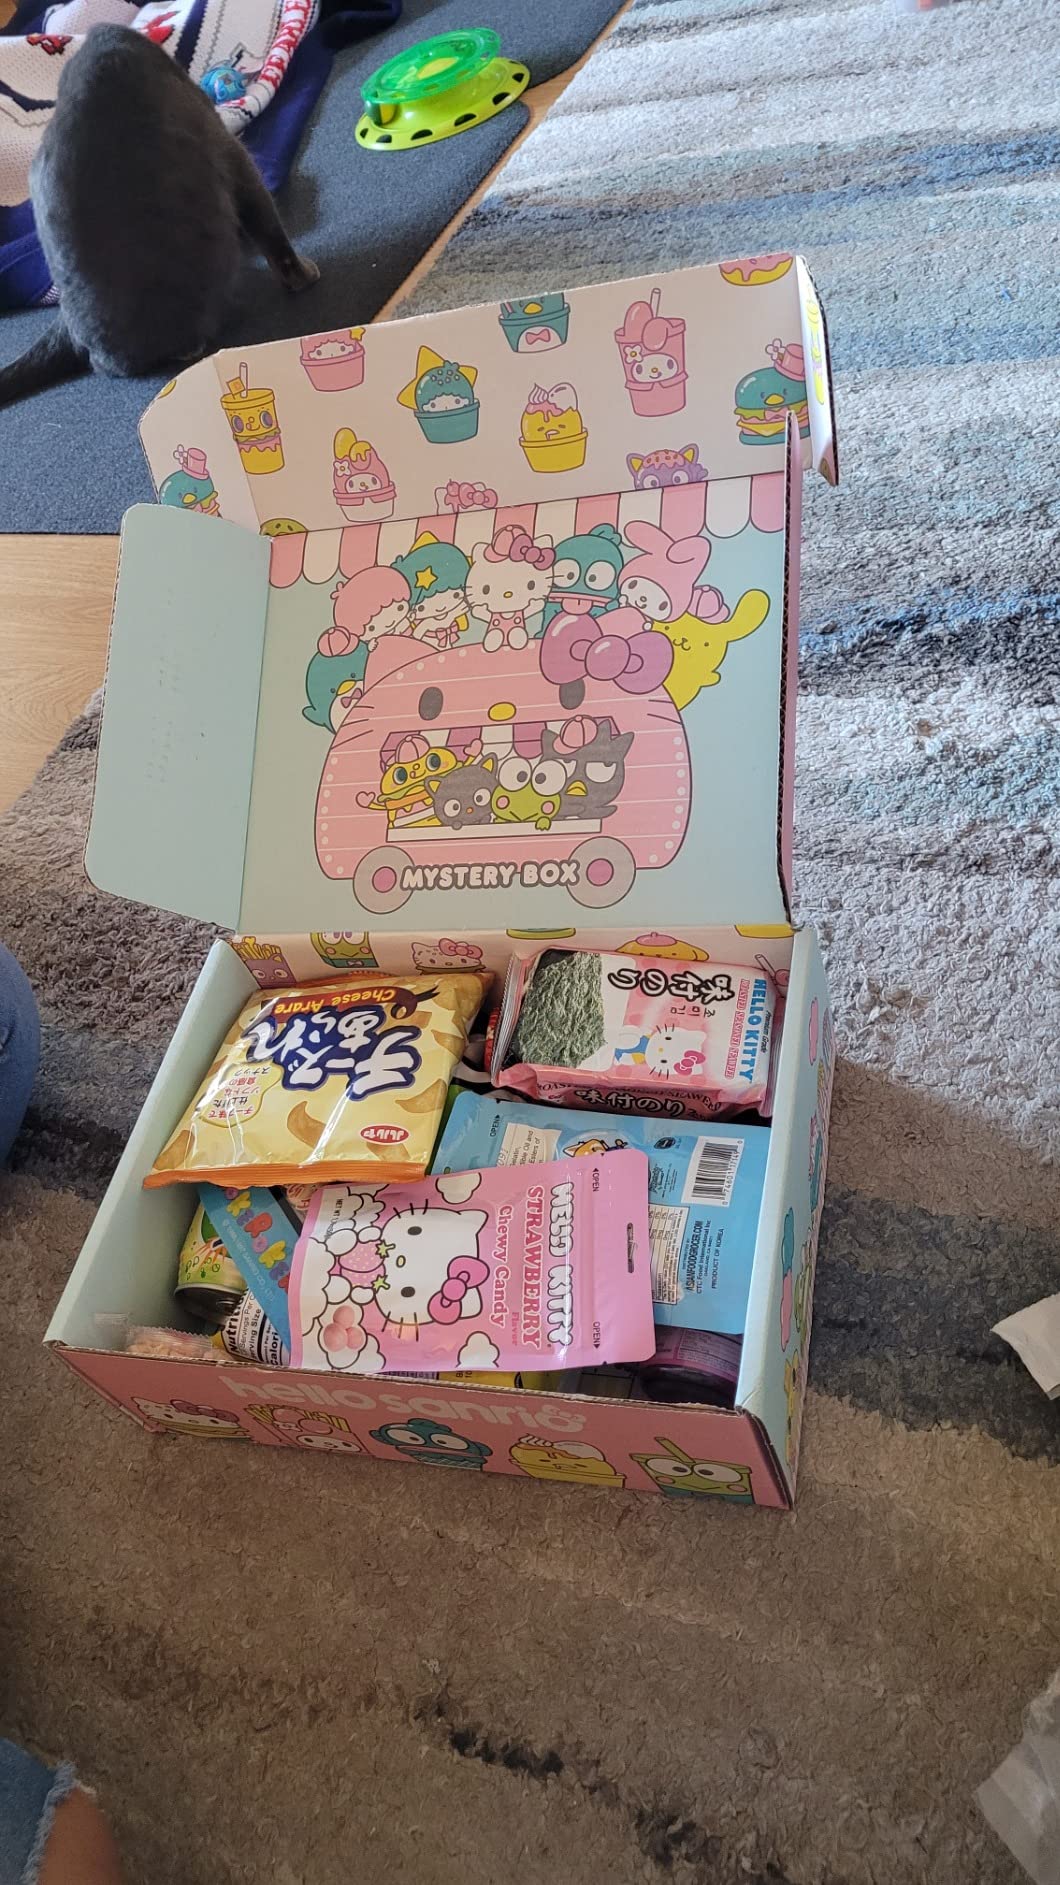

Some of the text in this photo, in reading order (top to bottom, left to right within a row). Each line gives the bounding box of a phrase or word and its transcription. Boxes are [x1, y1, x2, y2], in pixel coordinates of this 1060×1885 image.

[401, 860, 580, 890] MYSTERY BOX
[274, 988, 396, 1014] Cheese Arare
[608, 968, 735, 1005] 味付のり
[249, 1010, 381, 1062] あられ
[739, 978, 767, 1082] HELLO KITTY
[762, 1010, 772, 1035] Premium
[286, 1029, 418, 1097] チーズ
[573, 1089, 686, 1118] 味付のり
[489, 1118, 501, 1137] OPEN
[592, 1172, 600, 1192] OPEN
[699, 1228, 709, 1264] International
[711, 1258, 719, 1289] PRODUCT
[716, 1228, 724, 1248] KOREA
[490, 1205, 513, 1328] Chewy Candy
[522, 1185, 544, 1349] STRAWBERRY
[252, 1308, 262, 1328] Size
[593, 1322, 601, 1343] OPEN
[270, 1331, 280, 1367] Calori
[219, 1375, 588, 1432] hello sanrio
